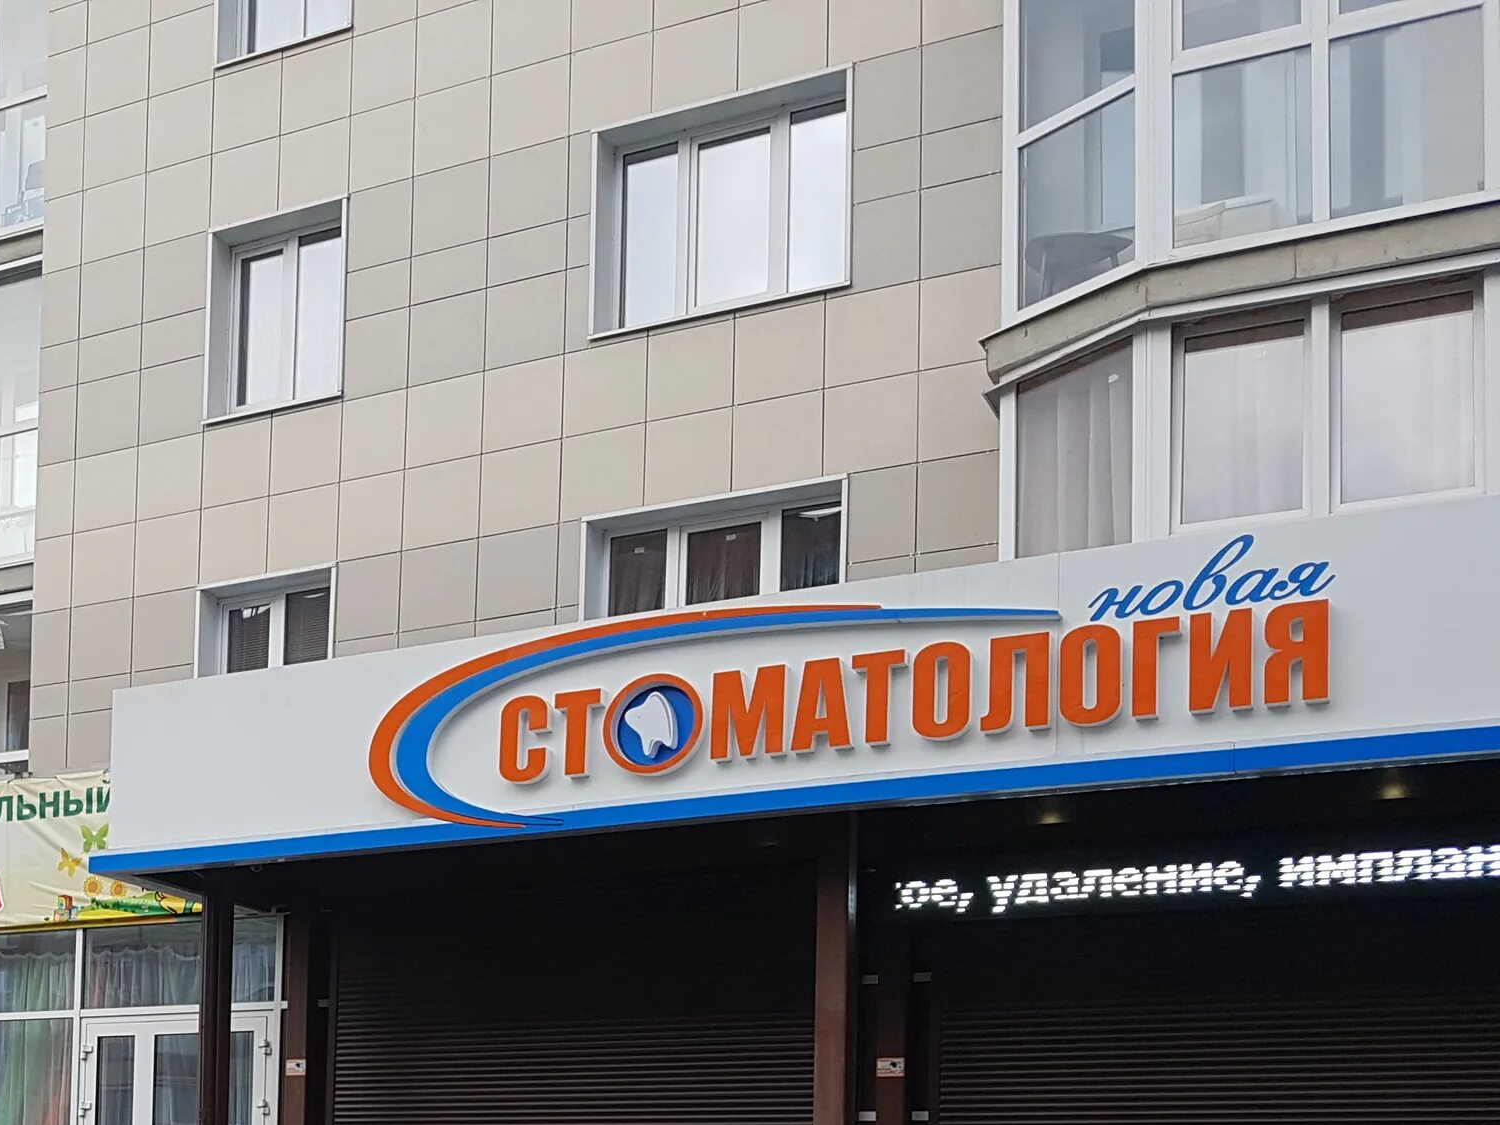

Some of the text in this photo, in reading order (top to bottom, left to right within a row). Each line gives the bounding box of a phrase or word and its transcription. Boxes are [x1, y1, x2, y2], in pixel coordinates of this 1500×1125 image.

[1089, 534, 1336, 622] новая
[499, 599, 1331, 784] СТОМАТОЛОГИЯ
[894, 878, 974, 914] ое,
[987, 861, 1262, 914] удаление,
